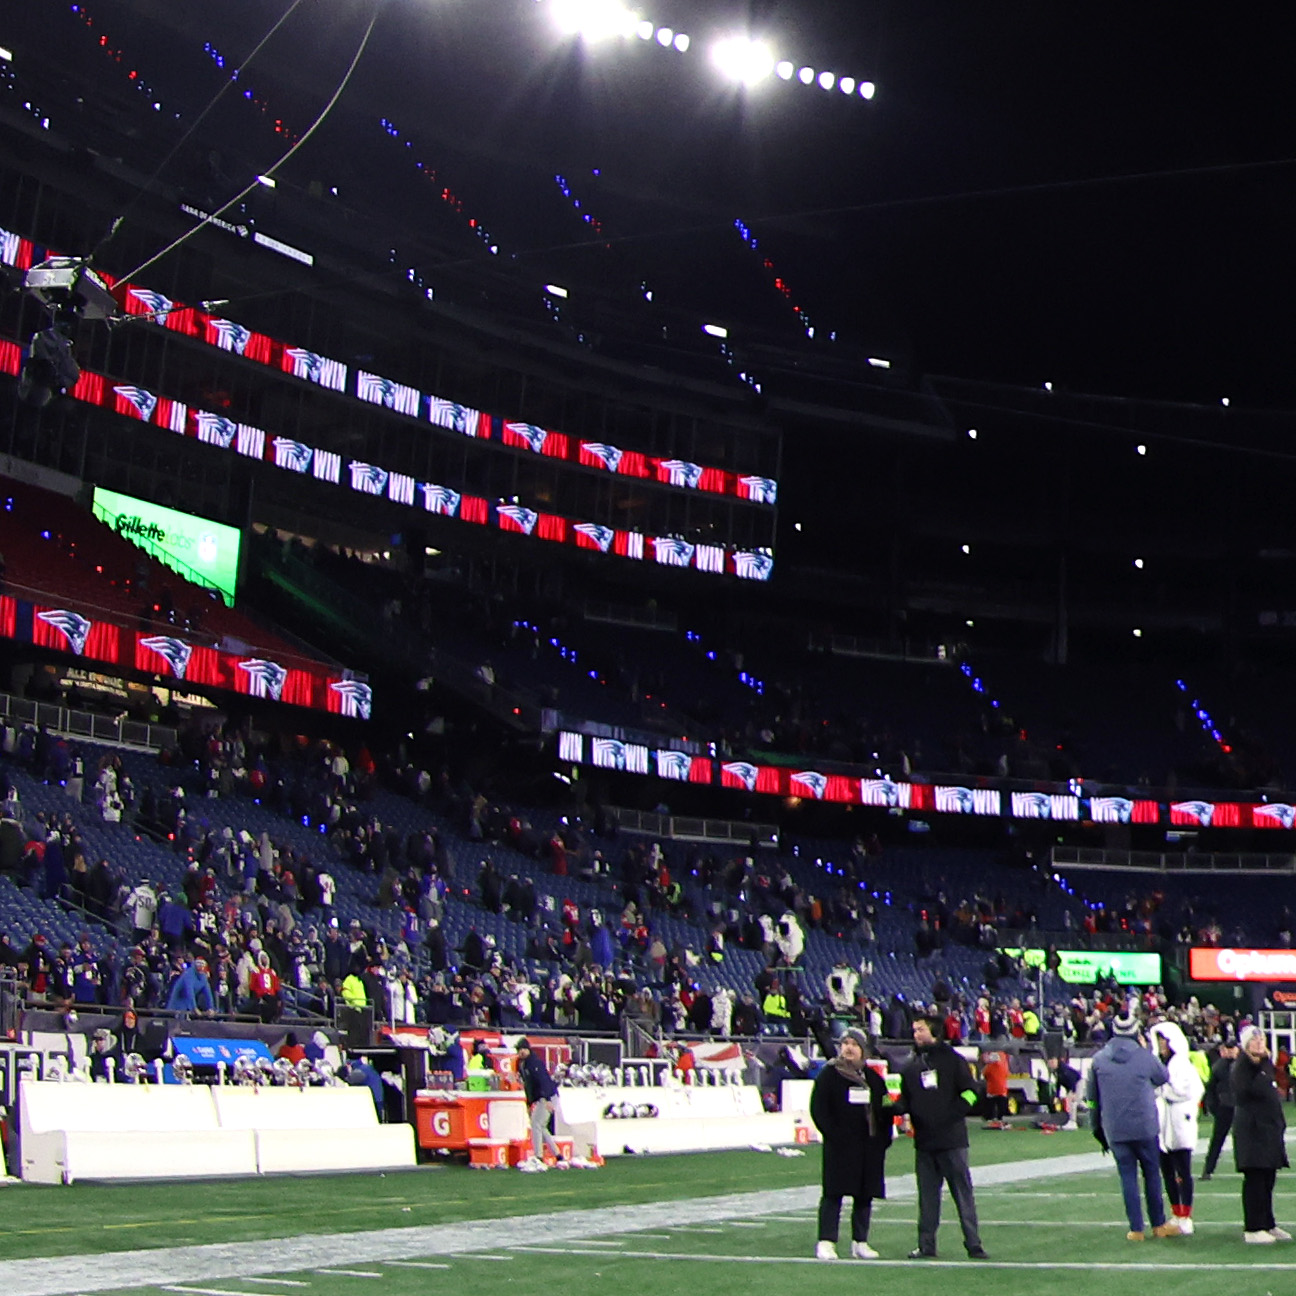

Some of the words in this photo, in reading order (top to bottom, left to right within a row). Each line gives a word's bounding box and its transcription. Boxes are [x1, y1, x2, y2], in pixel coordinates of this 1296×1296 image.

[319, 357, 347, 394] WIN
[394, 383, 420, 418] WIN
[237, 423, 265, 460] WIN
[314, 448, 341, 485] WIN
[388, 471, 415, 506] WIN
[696, 544, 724, 574] WIN
[559, 731, 583, 763] WIN
[625, 743, 649, 775] WIN
[973, 789, 1000, 815] WIN
[1050, 795, 1079, 820] WIN
[432, 1111, 451, 1137] G
